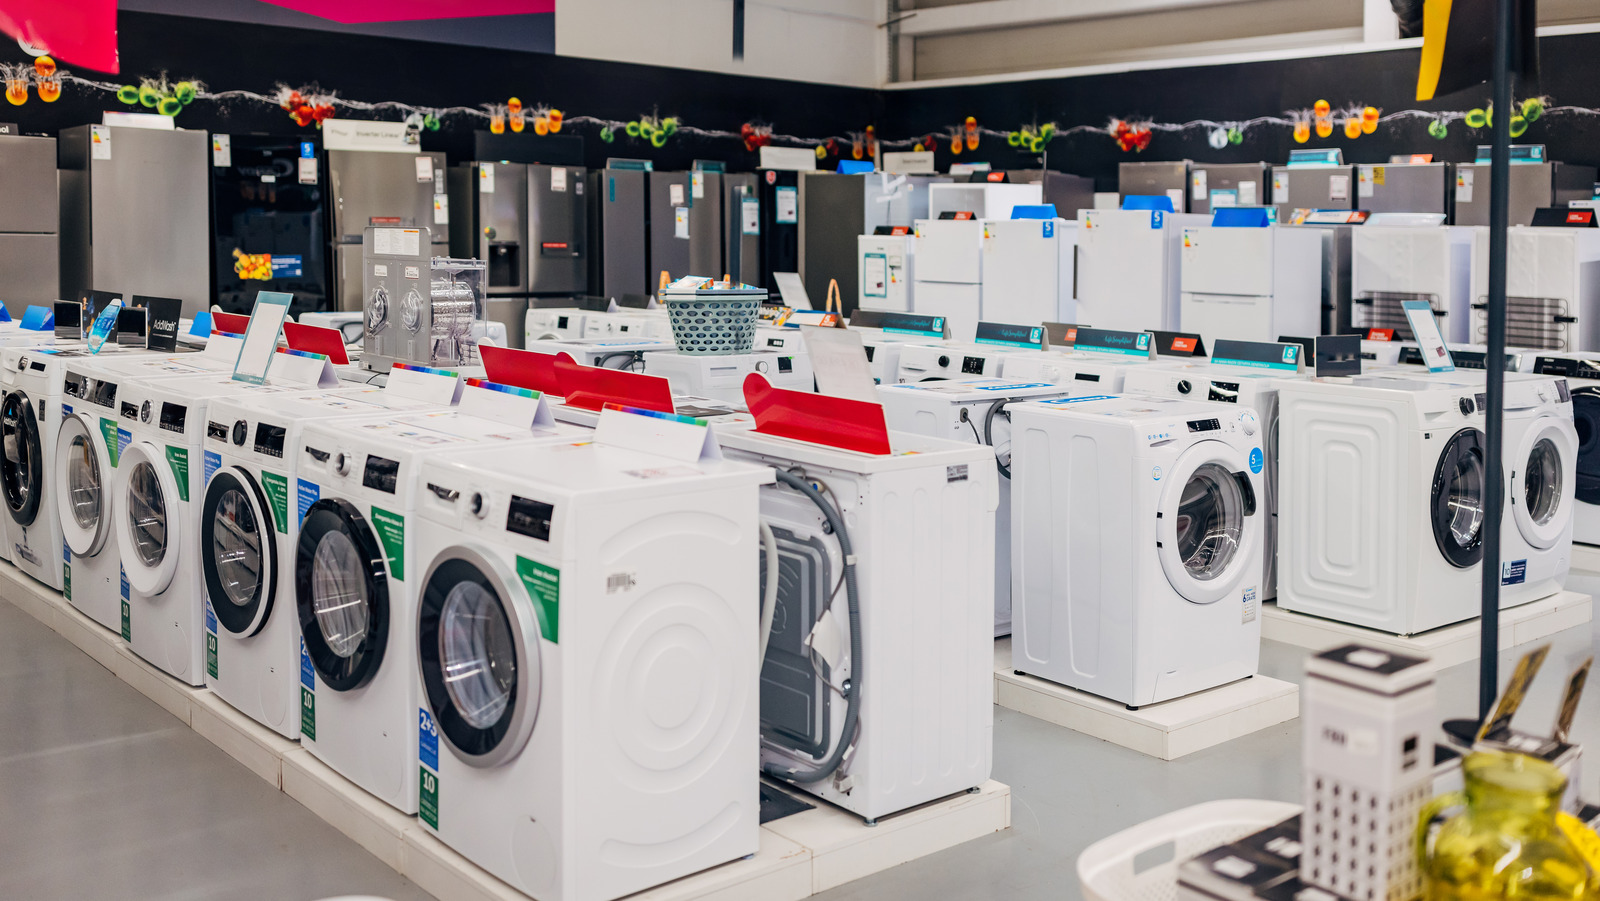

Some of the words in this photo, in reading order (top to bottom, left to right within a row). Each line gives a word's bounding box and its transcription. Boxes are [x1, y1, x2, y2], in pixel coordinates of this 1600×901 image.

[0, 125, 9, 134] ol
[1154, 211, 1161, 222] 5
[1045, 222, 1051, 231] 5
[935, 319, 941, 327] 5
[1033, 329, 1039, 338] 5
[1140, 336, 1146, 345] 5
[1287, 349, 1294, 358] 5
[1251, 454, 1256, 465] 5
[208, 636, 216, 652] 10
[303, 691, 312, 709] 10
[420, 711, 437, 737] 2+3
[423, 771, 435, 794] 10
